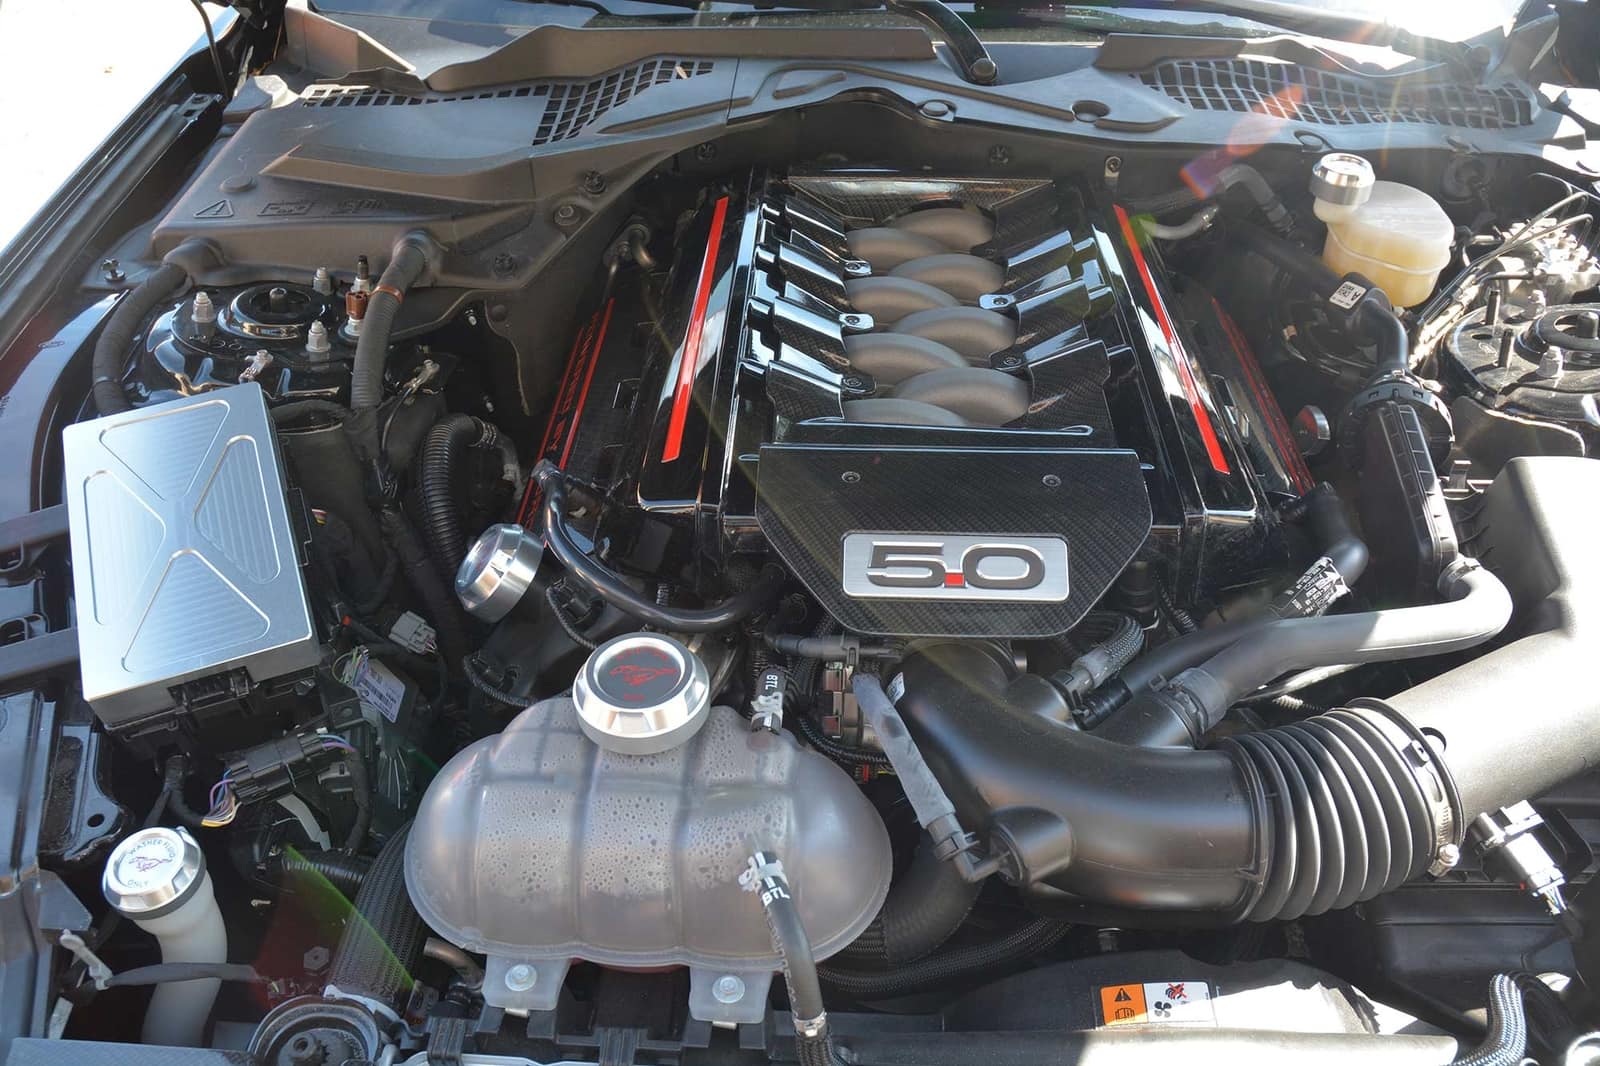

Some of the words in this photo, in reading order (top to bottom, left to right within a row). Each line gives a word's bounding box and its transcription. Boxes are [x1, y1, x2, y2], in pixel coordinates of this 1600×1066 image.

[866, 541, 1046, 590] 5.0
[129, 839, 161, 855] WASHER
[127, 879, 149, 889] ONLY
[762, 886, 790, 906] BTL
